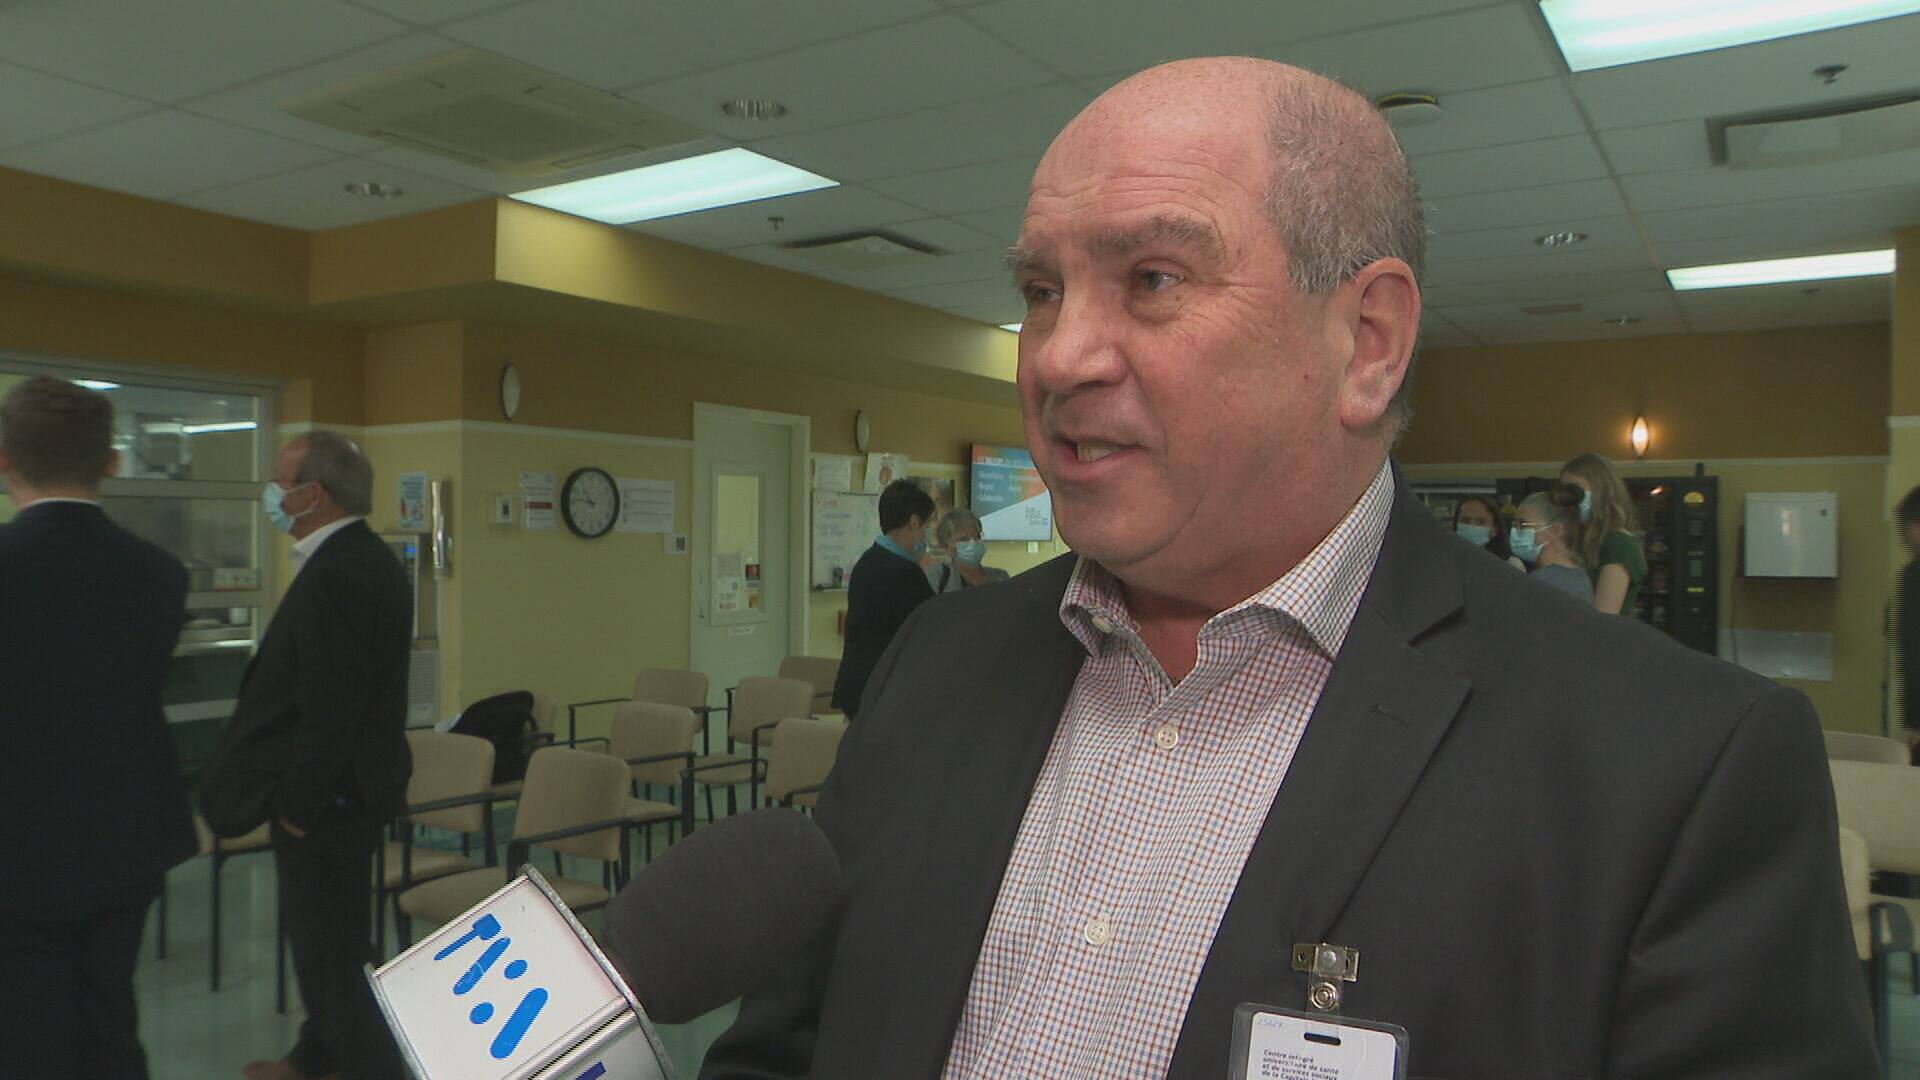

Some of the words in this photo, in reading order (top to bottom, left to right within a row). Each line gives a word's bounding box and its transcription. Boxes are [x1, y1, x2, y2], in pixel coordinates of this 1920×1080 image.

[1263, 1049, 1287, 1059] Centre
[1282, 1067, 1309, 1077] services
[1319, 1066, 1339, 1075] santé
